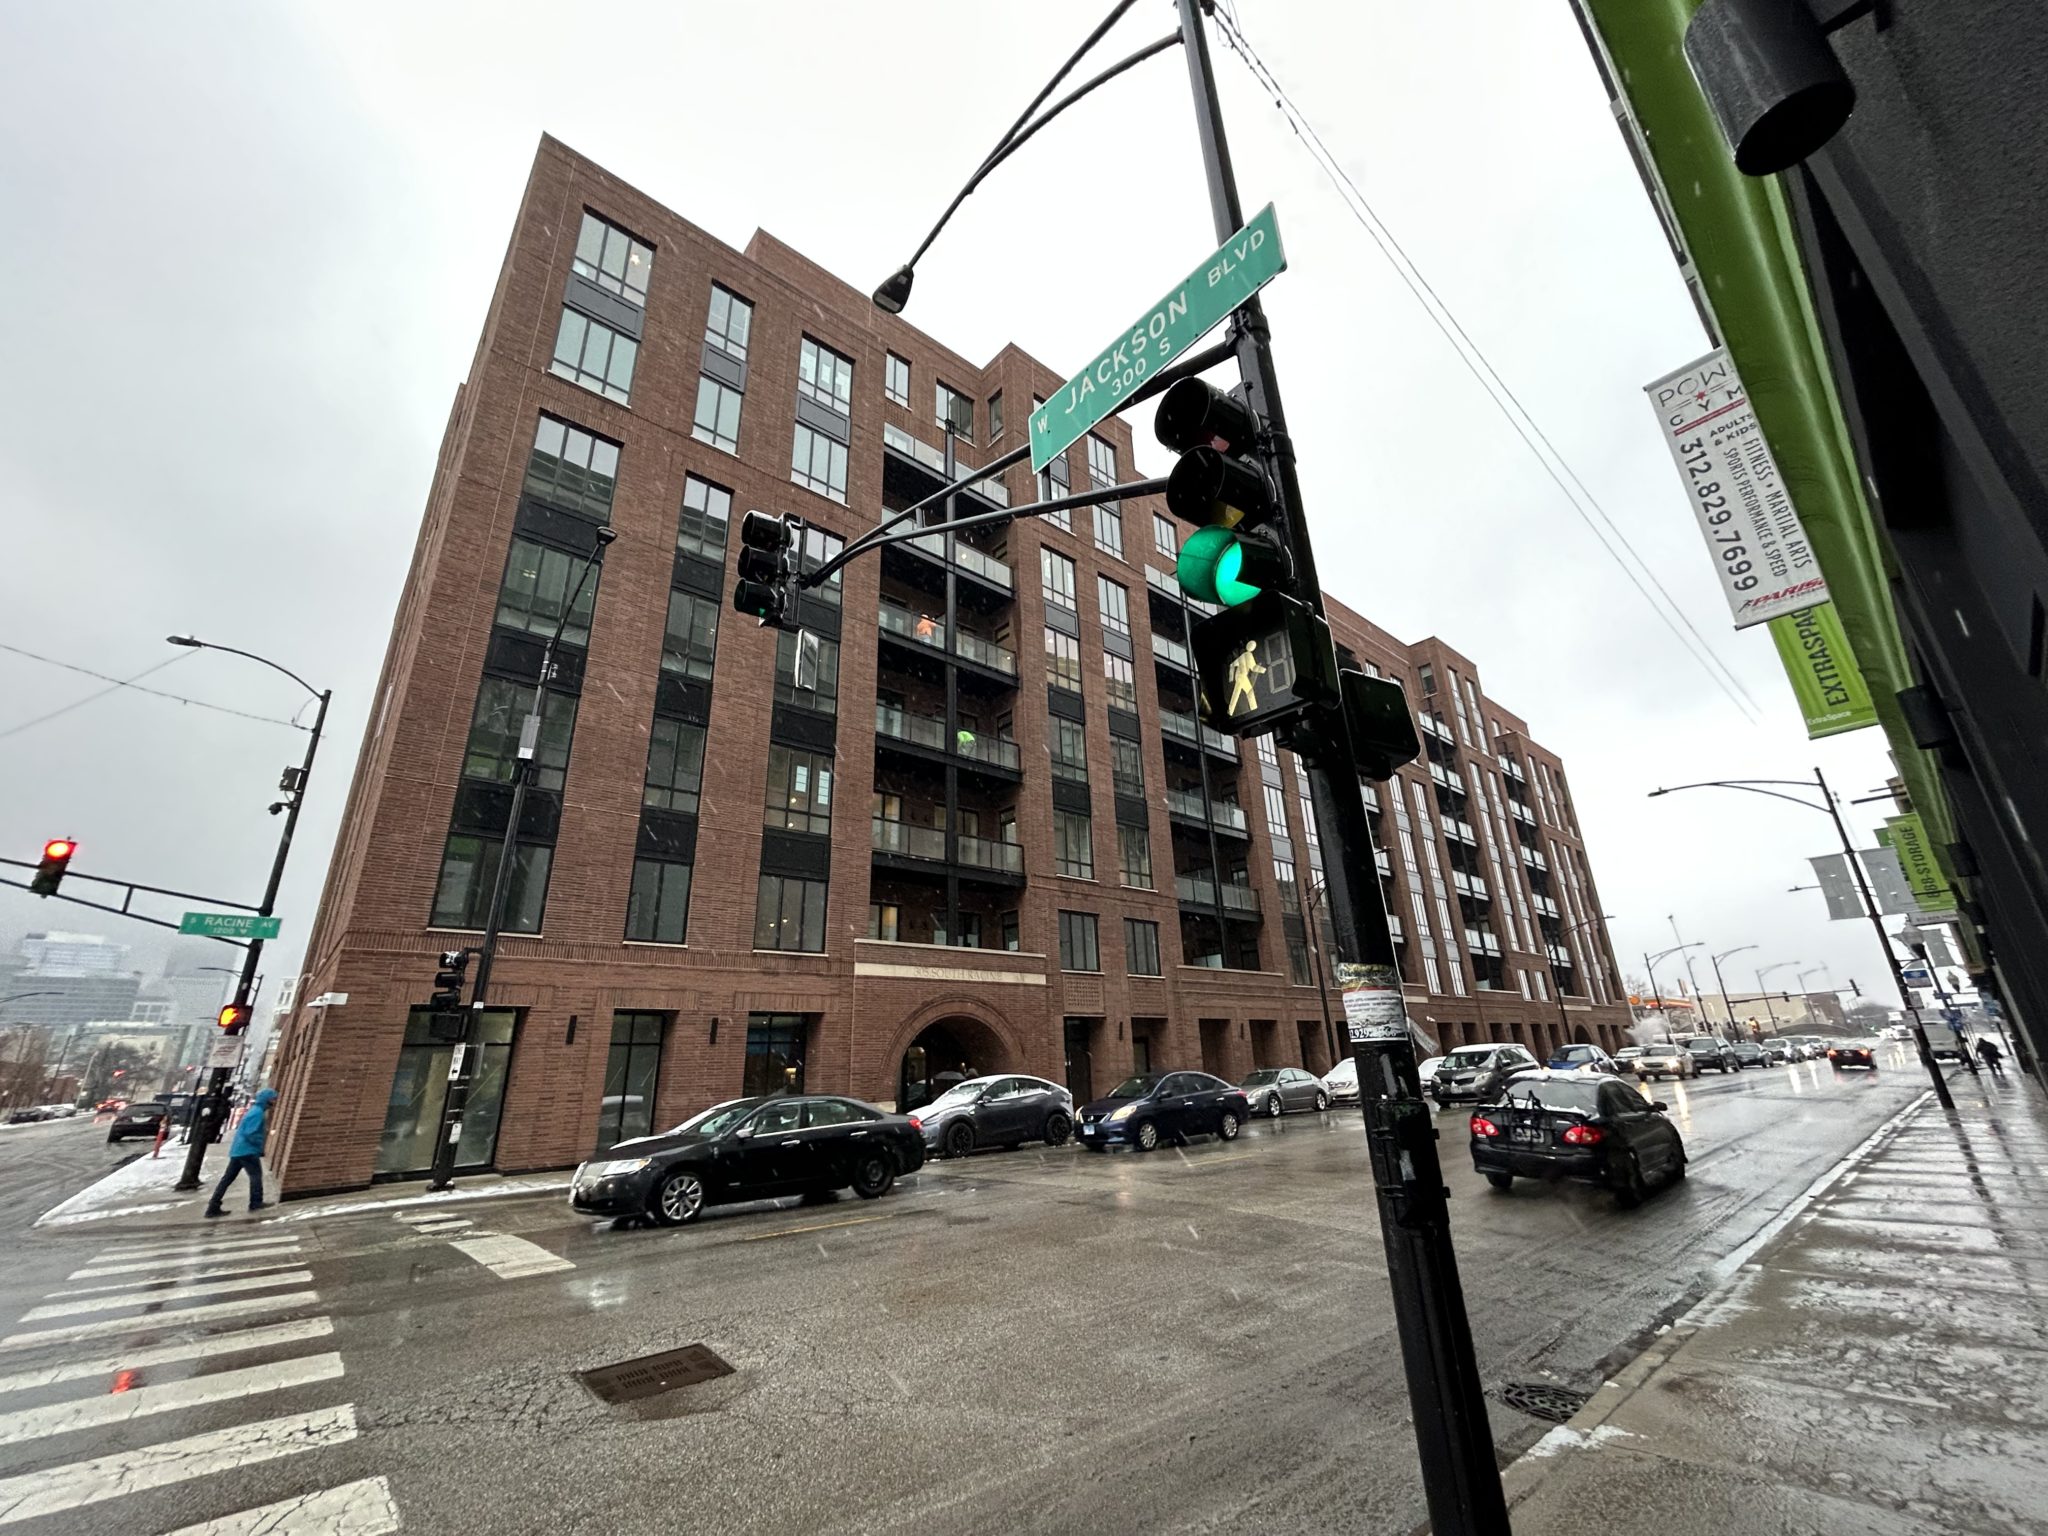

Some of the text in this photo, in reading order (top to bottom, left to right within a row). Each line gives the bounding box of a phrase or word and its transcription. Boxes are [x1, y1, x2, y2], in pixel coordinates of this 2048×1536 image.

[1036, 229, 1265, 433] W JACKSON BLVD
[1112, 337, 1171, 396] 300 S
[1714, 422, 1757, 446] & KIDS
[1681, 437, 1758, 591] 312.829.7699
[1724, 447, 1788, 577] SPORTS PERFORMANCE & SPEED
[1742, 437, 1774, 481] FITNESS
[1765, 490, 1799, 539] MARTIAL
[1785, 540, 1812, 569] ARTS
[204, 917, 254, 928] RACINE
